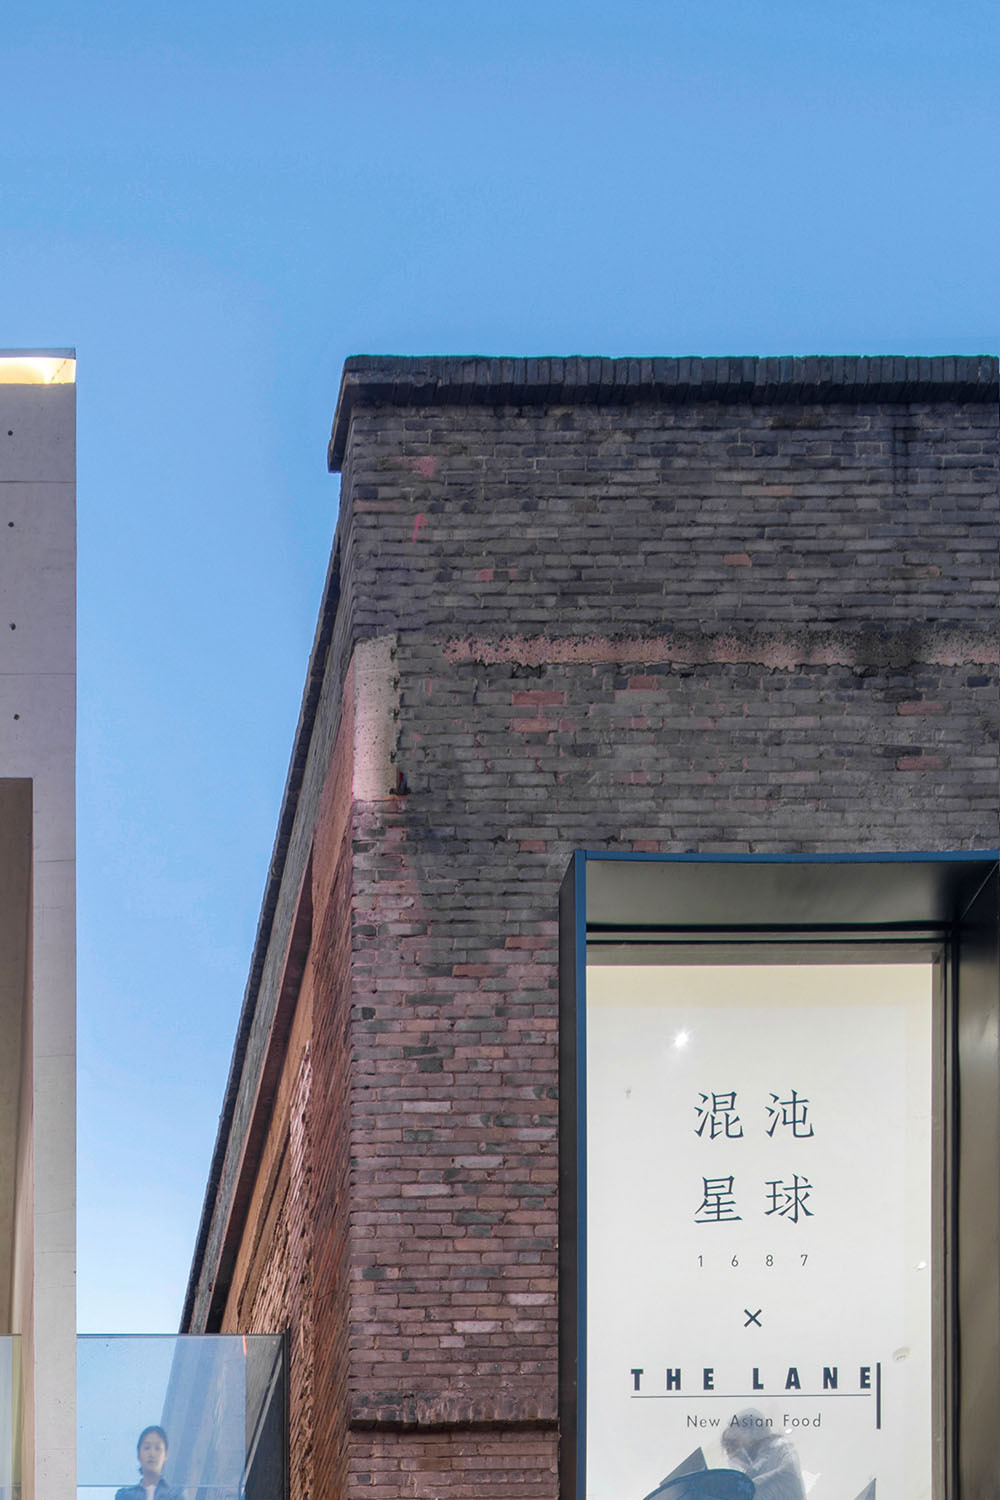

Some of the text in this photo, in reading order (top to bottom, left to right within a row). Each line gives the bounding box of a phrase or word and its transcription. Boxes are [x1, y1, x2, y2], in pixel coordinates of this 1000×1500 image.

[693, 1090, 815, 1141] 混沌
[693, 1173, 815, 1225] 星球
[697, 1254, 809, 1268] 1687
[630, 1366, 872, 1392] THE LANE
[686, 1412, 822, 1428] New Asian Food
